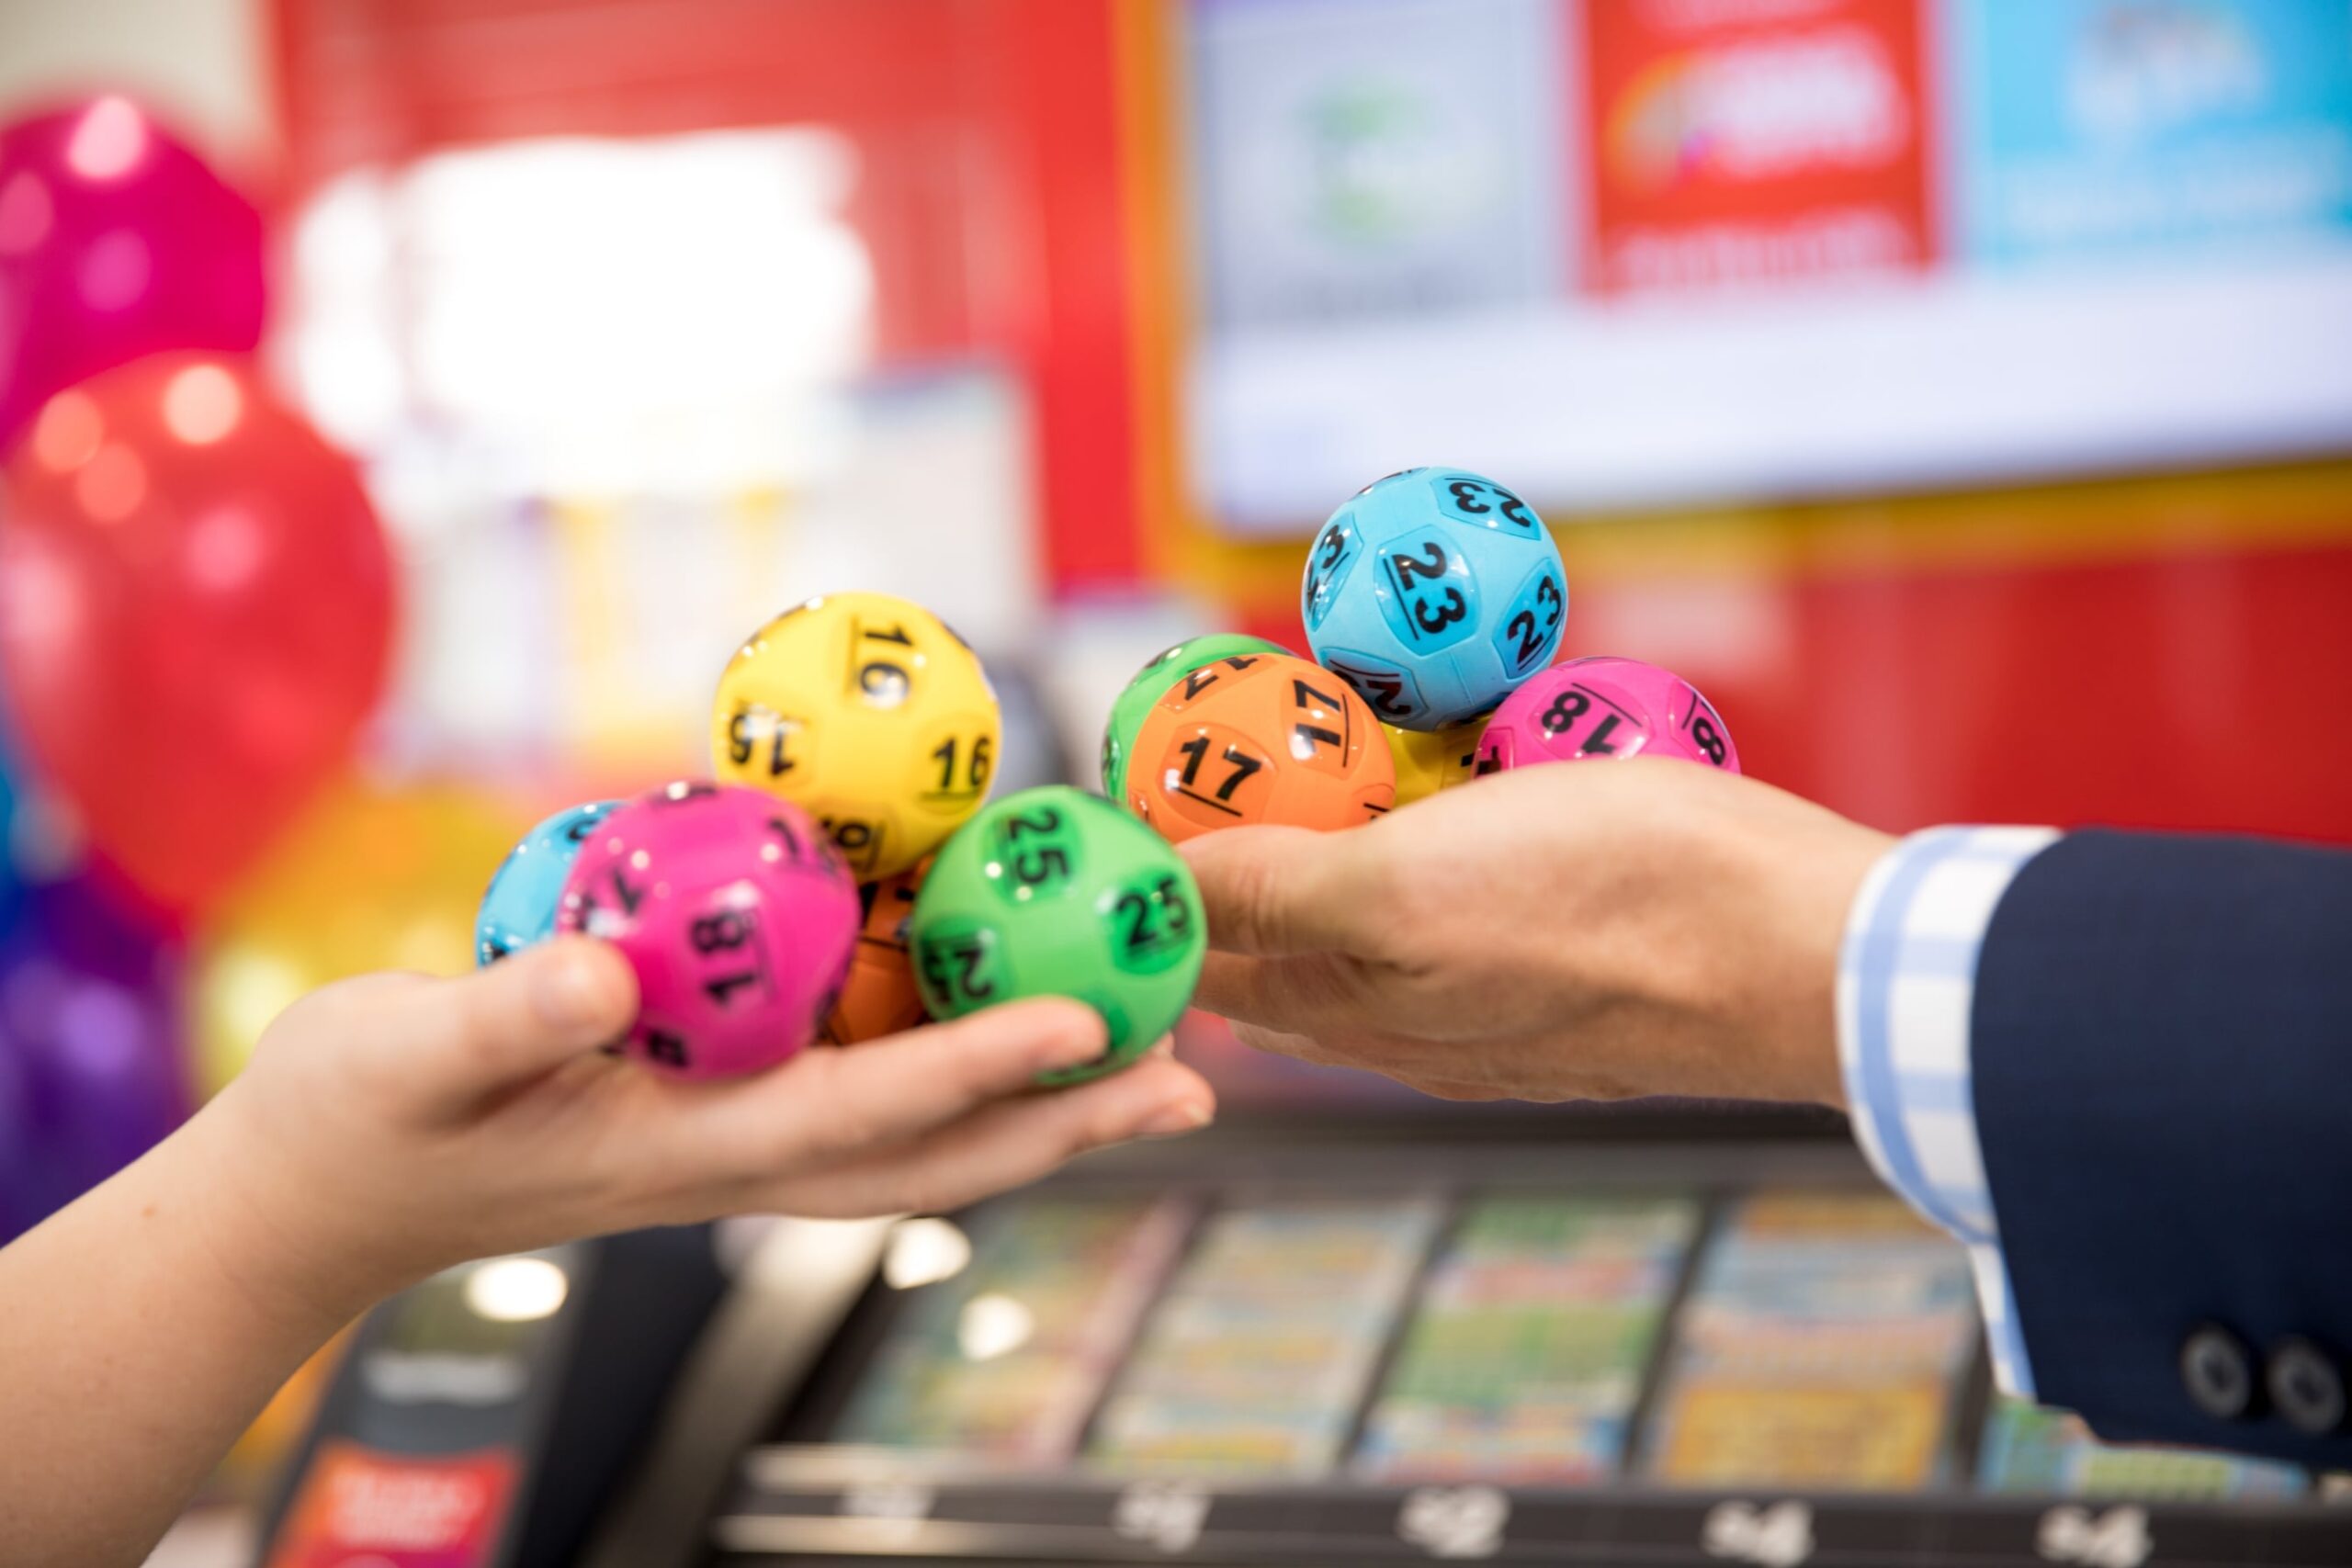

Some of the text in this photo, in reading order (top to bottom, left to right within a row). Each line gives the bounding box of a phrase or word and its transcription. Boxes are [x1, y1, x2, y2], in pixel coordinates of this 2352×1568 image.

[1449, 481, 1532, 528] 23
[1390, 542, 1467, 634] 23
[1507, 575, 1562, 665] 23
[864, 626, 915, 709] 16
[729, 714, 797, 777] 16
[1293, 679, 1341, 761] 17
[1542, 691, 1622, 755] 18
[932, 737, 990, 788] 16
[1180, 737, 1262, 802] 17
[1008, 807, 1069, 884] 25
[1116, 877, 1189, 947] 25
[691, 911, 757, 1007] 18
